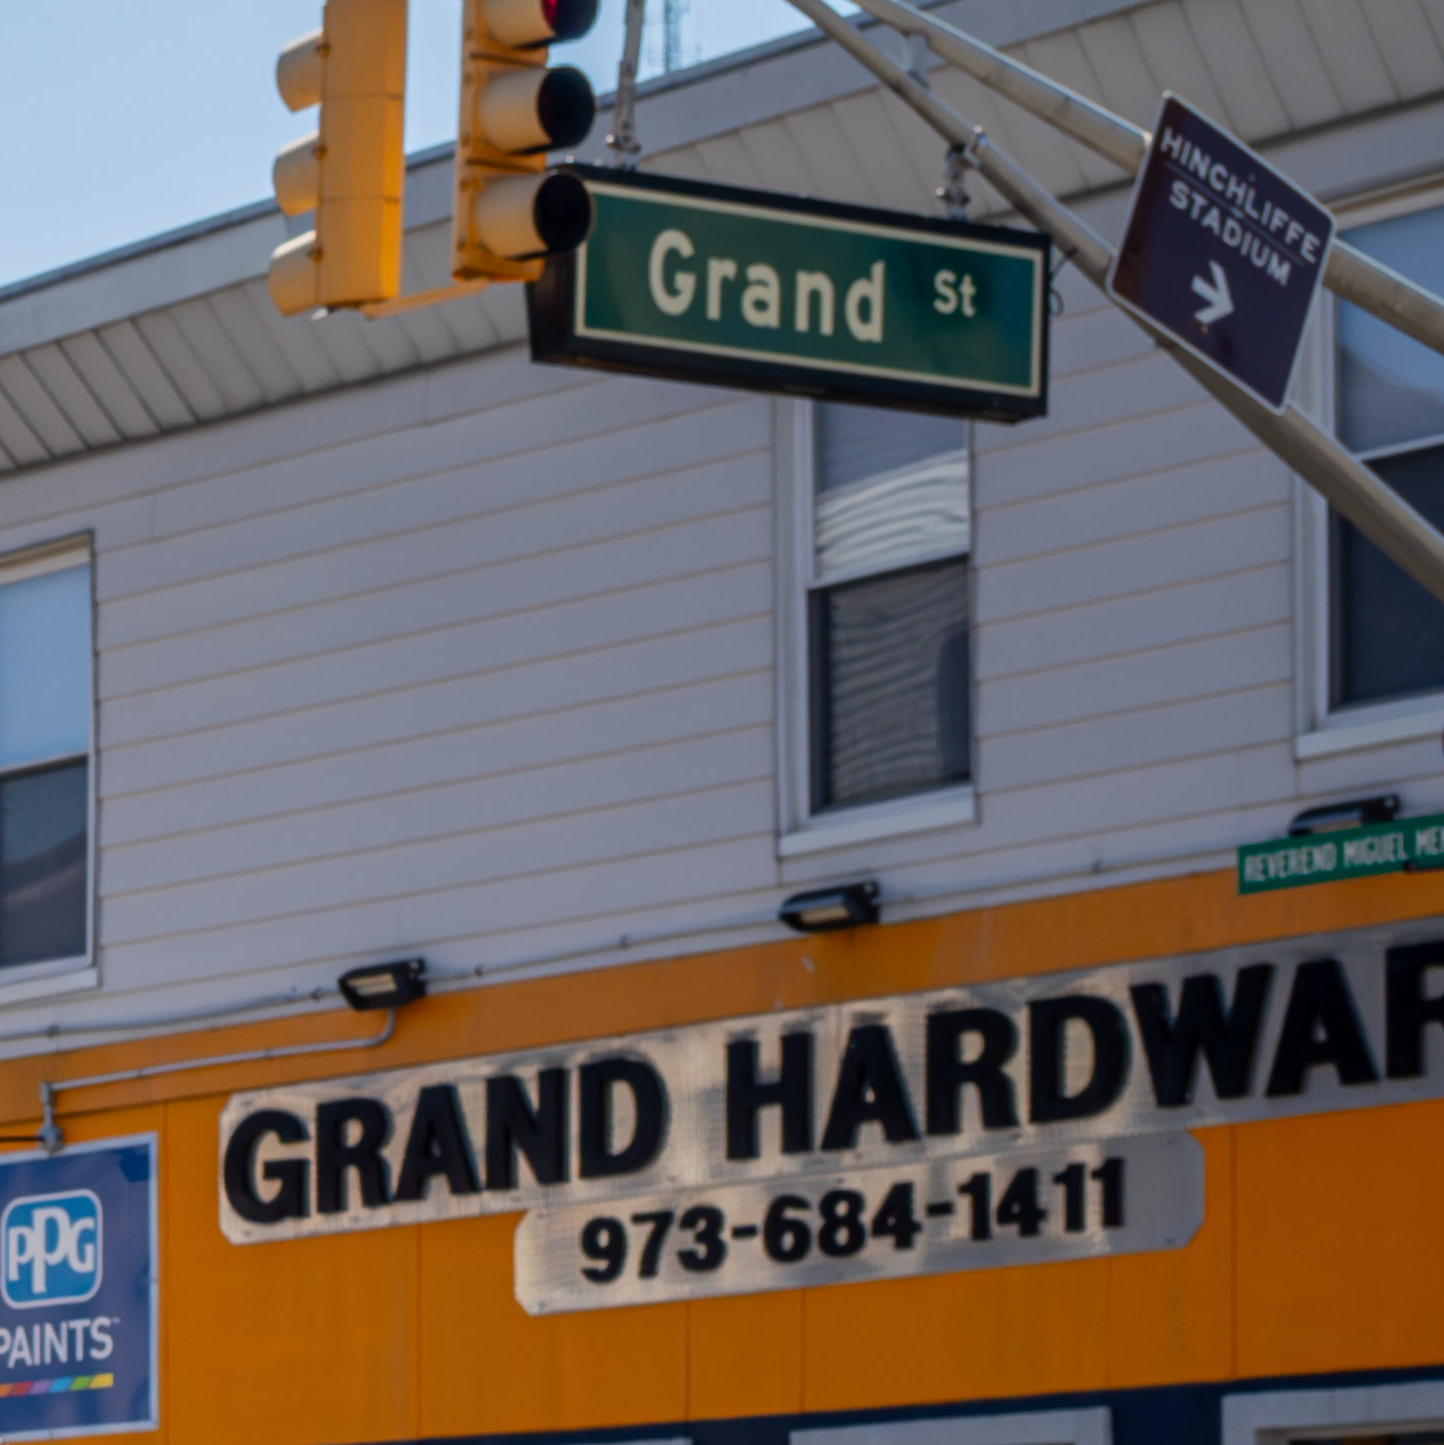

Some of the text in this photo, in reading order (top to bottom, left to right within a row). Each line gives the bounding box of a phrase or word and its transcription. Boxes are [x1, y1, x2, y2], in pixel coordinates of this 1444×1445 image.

[1160, 127, 1321, 263] HINCHLIFFE
[1169, 180, 1292, 286] STADIUM
[648, 229, 976, 343] Grand St
[1244, 842, 1337, 882] REVEREND
[1343, 832, 1409, 867] MIGUEL
[223, 1058, 669, 1225] GRAND
[8, 1206, 95, 1293] PPG
[580, 1157, 1125, 1285] 973-684-1411
